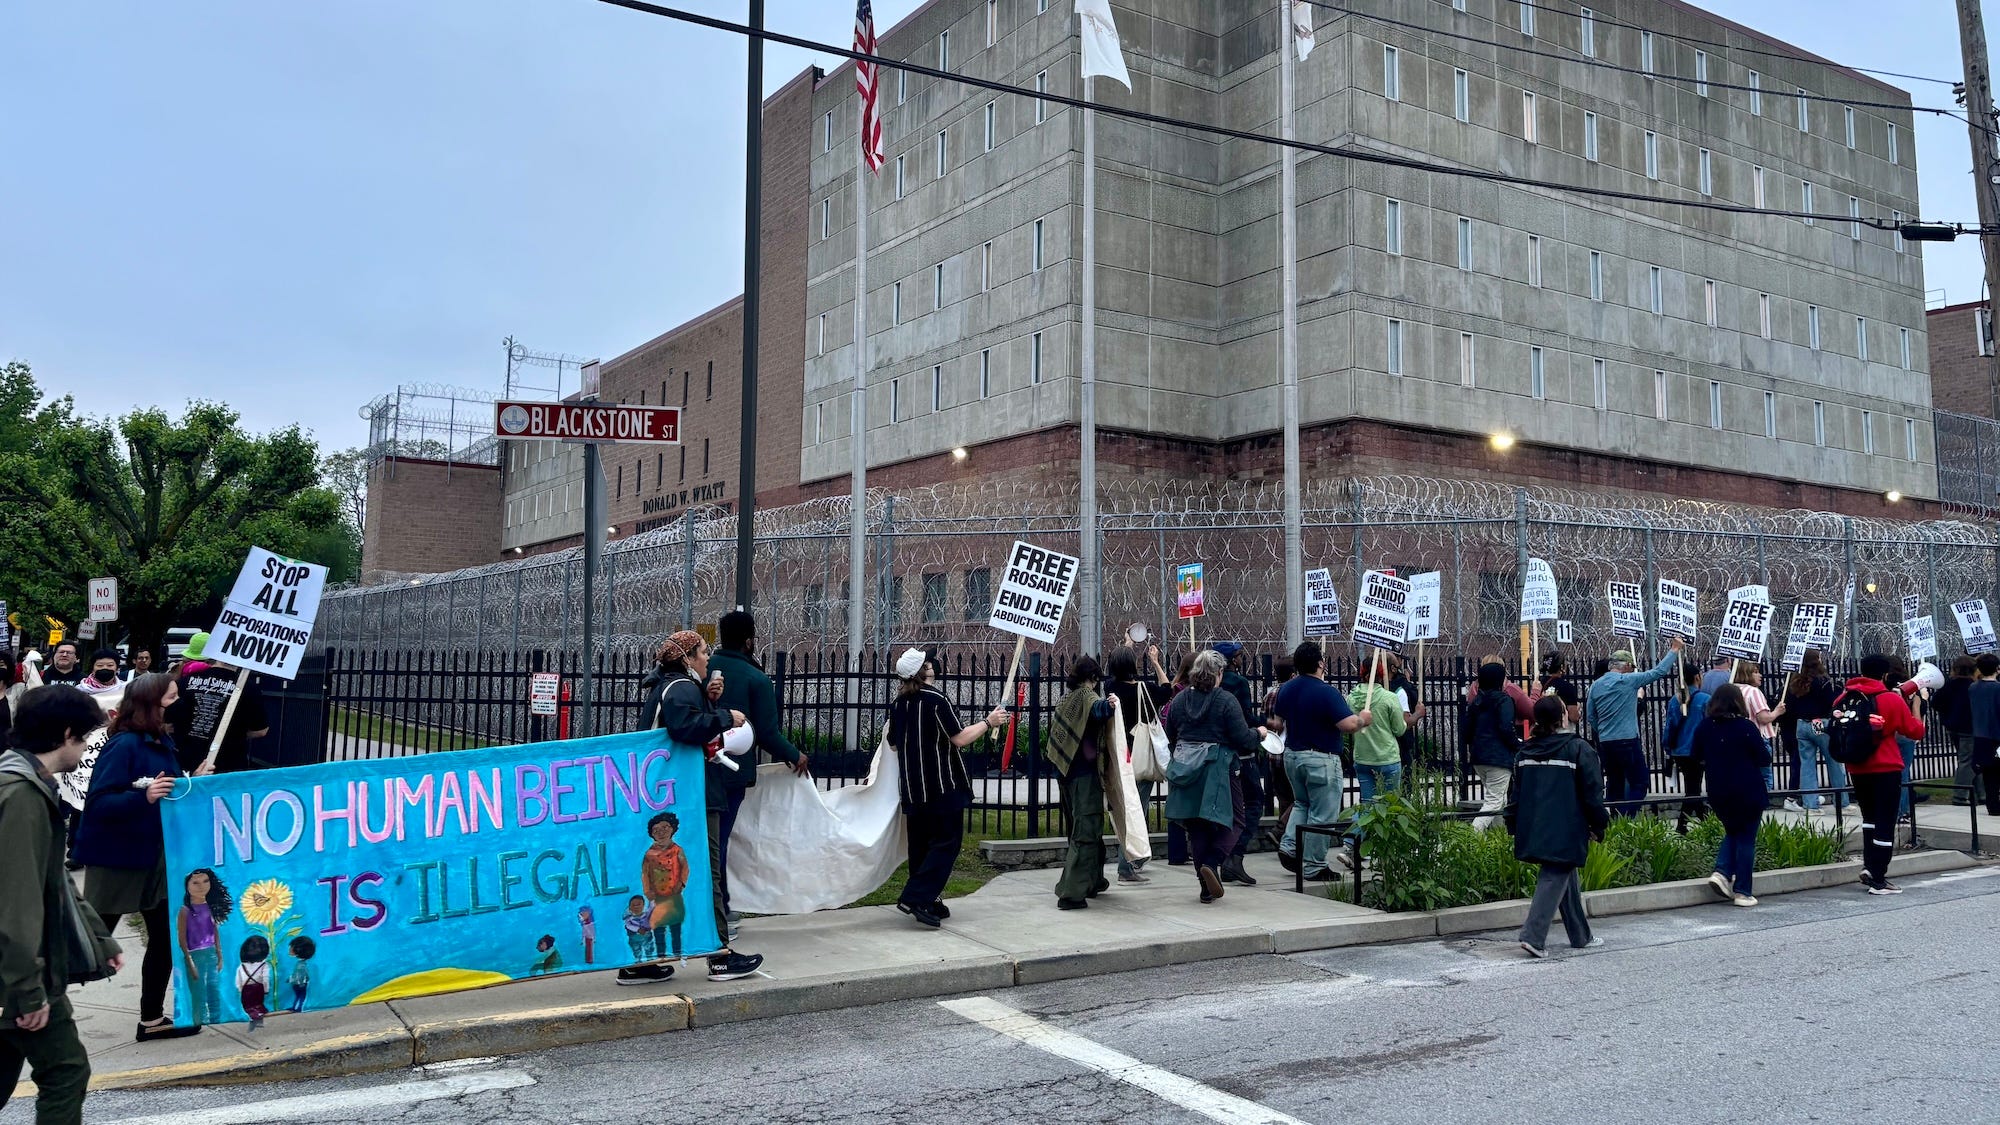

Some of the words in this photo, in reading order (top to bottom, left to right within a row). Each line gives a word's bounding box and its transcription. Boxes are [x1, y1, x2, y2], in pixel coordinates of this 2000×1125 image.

[531, 407, 655, 438] BLACKSTONE
[662, 425, 674, 439] ST
[643, 493, 677, 515] DONALD
[679, 490, 690, 505] W.
[693, 481, 725, 504] WYATT
[261, 557, 310, 587] STOP
[1013, 544, 1075, 582] FREE
[1008, 567, 1068, 597] ROSANE
[1307, 571, 1326, 581] MONEY
[1367, 574, 1380, 584] ¡EL
[1381, 577, 1411, 593] PUEBLO
[96, 587, 110, 598] NO
[252, 582, 298, 616] ALL
[1369, 583, 1406, 605] UNIDO
[1610, 582, 1640, 600] FREE
[1661, 583, 1680, 597] END
[1681, 588, 1695, 603] ICE
[91, 603, 115, 613] PARKING
[998, 589, 1032, 612] END
[1034, 599, 1062, 621] ICE
[1307, 604, 1320, 616] NOT
[1322, 603, 1338, 615] FOR
[1416, 605, 1430, 619] FREE
[1611, 597, 1641, 611] ROSANE
[1729, 600, 1770, 621] FREE
[1796, 604, 1834, 618] FREE
[1903, 596, 1917, 611] FREE
[1955, 600, 1983, 614] DEFEND
[993, 608, 1056, 635] ABDUCTIONS:
[1359, 611, 1364, 619] A
[1365, 612, 1377, 622] LAS
[1379, 616, 1405, 630] FAMILIAS
[1612, 609, 1628, 620] END
[1630, 611, 1643, 623] ALL
[1661, 609, 1681, 622] FREE
[1682, 614, 1694, 627] OUR
[1729, 615, 1762, 632] G.M.G
[1792, 618, 1812, 632] FREE
[1966, 613, 1981, 624] OUR
[220, 609, 308, 645] DEPORATIONS
[1357, 619, 1403, 639] MIGRANTES!
[1559, 623, 1570, 640] 11
[1722, 628, 1742, 640] END
[1744, 632, 1762, 644] ALL
[1813, 628, 1831, 637] ALL
[221, 630, 290, 668] NOW!
[212, 789, 304, 867] NO
[313, 767, 503, 853] HUMAN
[514, 748, 678, 828] BEING
[316, 871, 388, 937] IS
[404, 840, 630, 925] ILLEGAL
